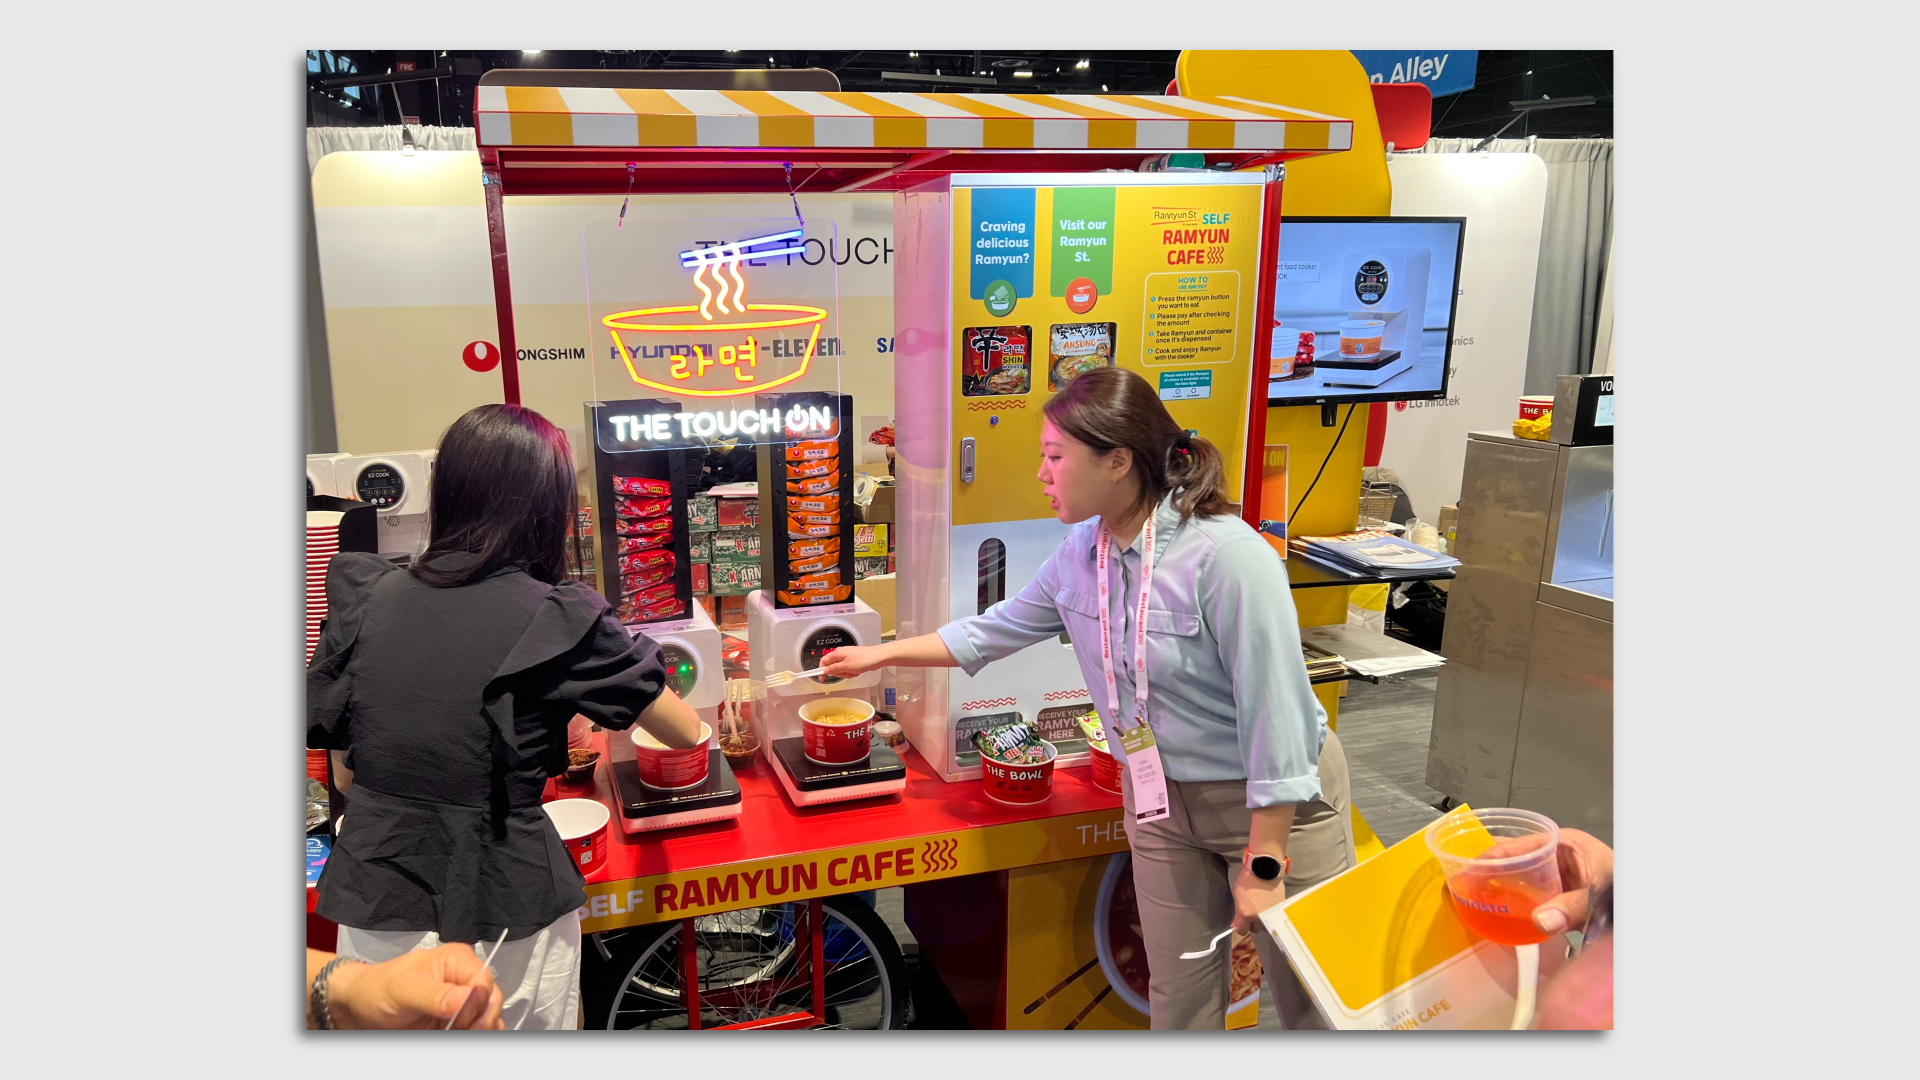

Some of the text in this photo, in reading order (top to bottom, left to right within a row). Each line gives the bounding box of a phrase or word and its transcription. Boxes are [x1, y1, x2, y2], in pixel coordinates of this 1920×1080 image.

[1389, 53, 1449, 84] Alley
[1154, 210, 1197, 220] Ramyun St
[1202, 213, 1230, 225] SELF
[980, 221, 1026, 234] Craving
[1060, 220, 1107, 231] Visit our
[1060, 236, 1107, 248] Ramyun
[1163, 228, 1229, 245] RAMYUN
[976, 238, 1029, 248] delicious
[975, 253, 1029, 265] Ramyun?
[1074, 252, 1090, 262] St.
[1167, 249, 1205, 265] CAFE
[1187, 294, 1210, 302] ramyun
[1177, 312, 1187, 320] pay
[1203, 310, 1230, 318] checking
[1063, 339, 1096, 350] ANSUNG
[1181, 335, 1211, 343] dispensed
[516, 348, 585, 361] ONGSHIM
[1183, 346, 1199, 354] enjoy
[670, 335, 756, 382] 라면
[1002, 356, 1023, 364] SHIN
[1600, 380, 1613, 392] VO
[1409, 400, 1423, 409] LG
[1523, 407, 1539, 415] THE
[609, 404, 830, 442] THE TOUCH ON
[1269, 451, 1285, 466] ON
[1138, 593, 1147, 646] Restaurant365
[1068, 708, 1087, 717] YOUR
[956, 716, 1009, 729] RECEIVE YOUR
[1037, 718, 1078, 731] RAMYU
[844, 727, 865, 740] THE
[1049, 728, 1075, 740] HERE
[986, 763, 1043, 781] THE BOWL
[1076, 820, 1126, 845] THE
[579, 847, 915, 920] SELF RAMYUN CAFE
[1391, 1008, 1411, 1022] CAFE
[1417, 998, 1452, 1023] CAFE
